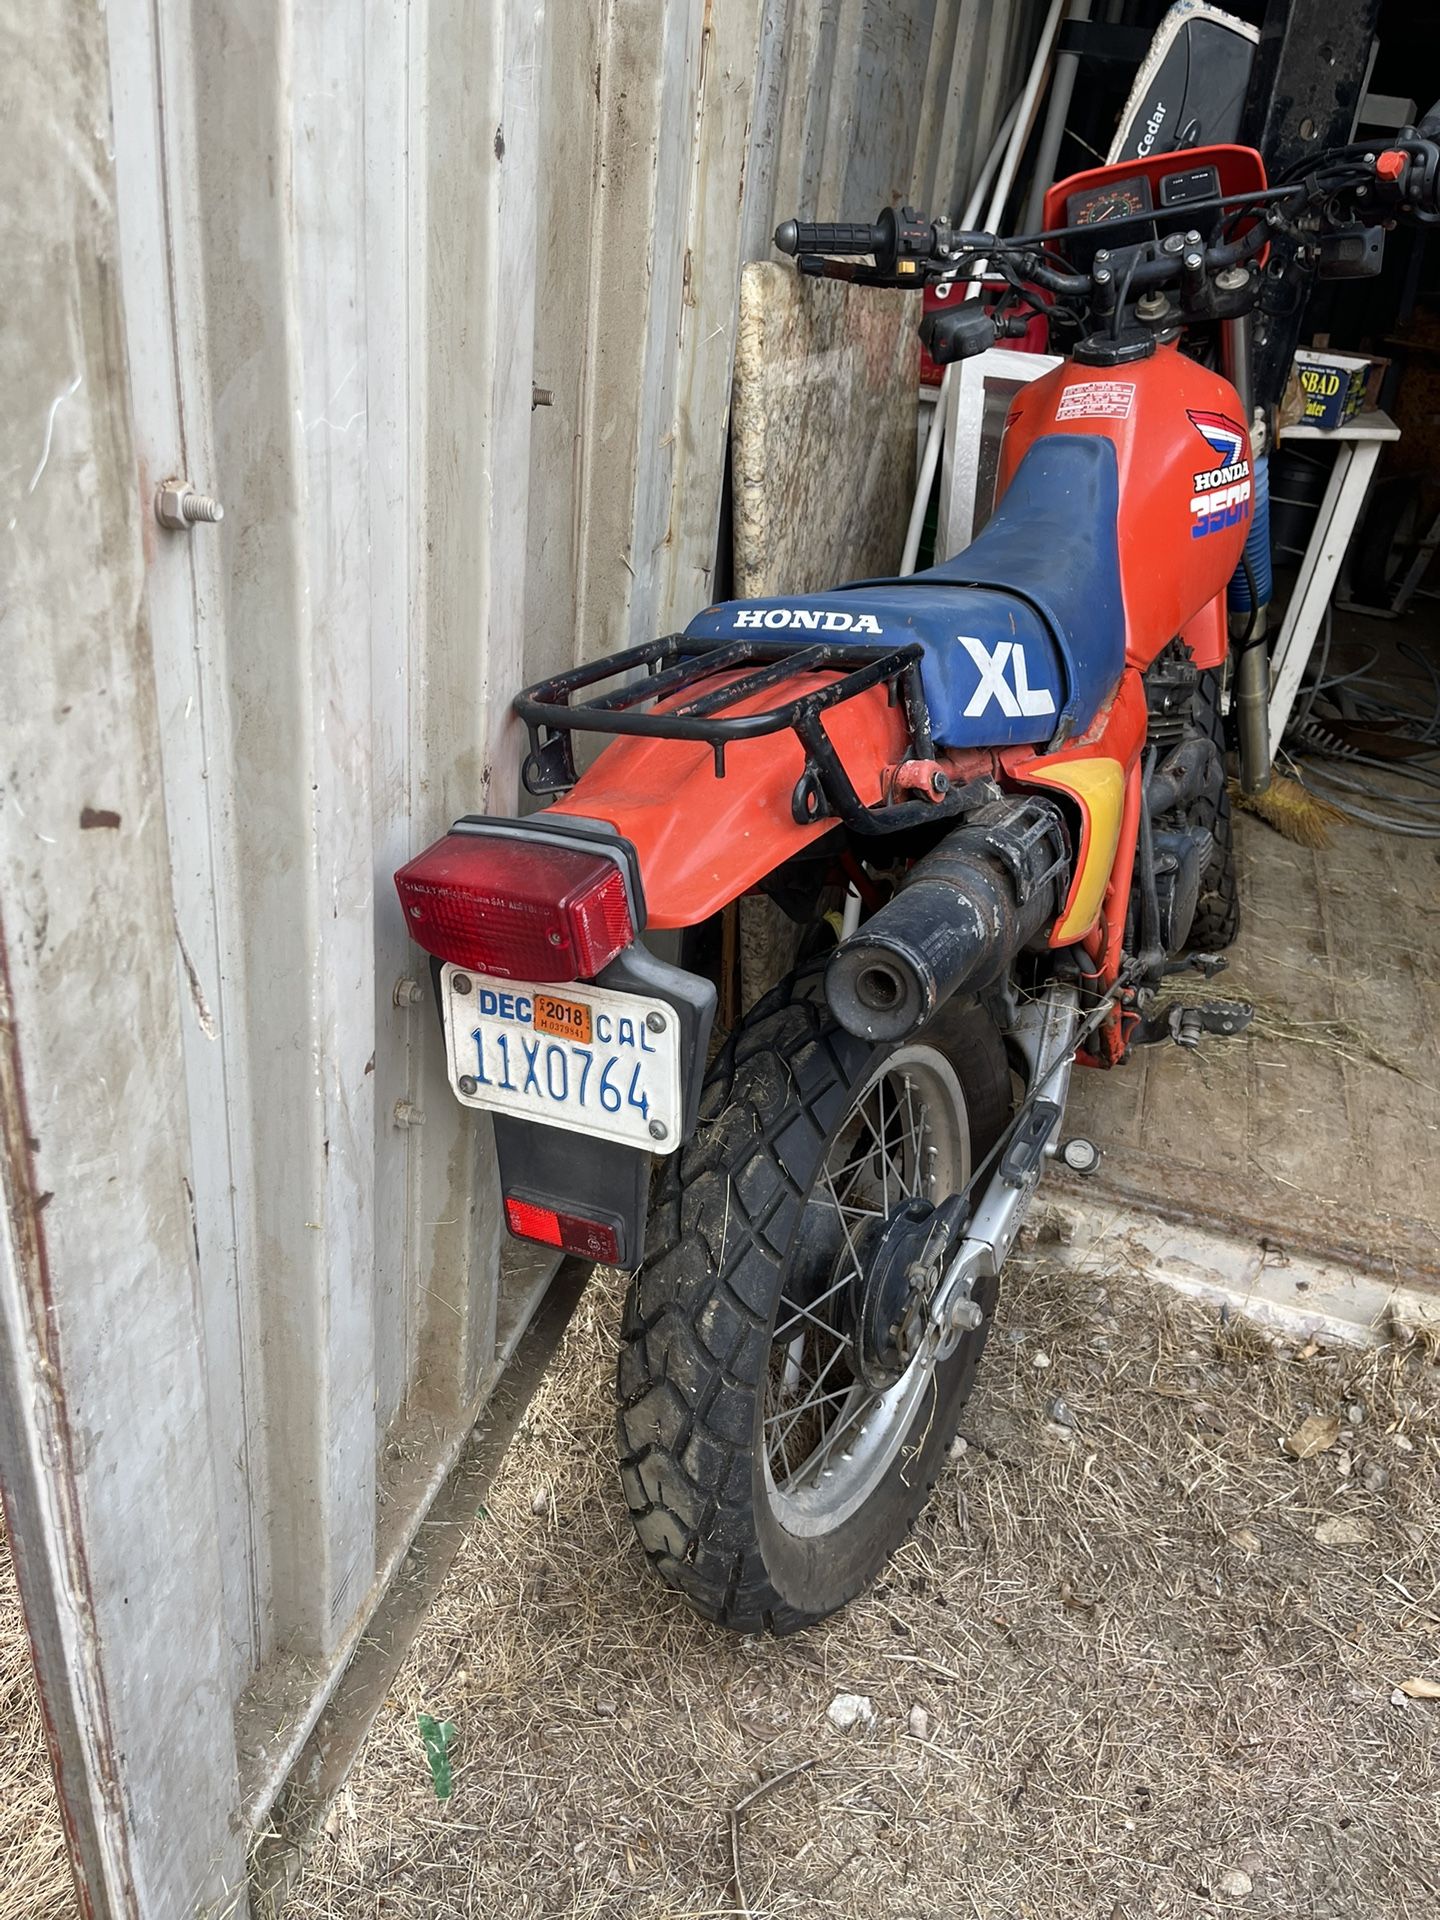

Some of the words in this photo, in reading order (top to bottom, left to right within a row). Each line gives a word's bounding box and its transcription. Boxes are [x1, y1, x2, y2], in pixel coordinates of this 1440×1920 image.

[1194, 460, 1250, 492] HONDA
[1190, 480, 1251, 539] 350R
[732, 609, 883, 634] HONDA
[957, 636, 1056, 718] XL
[479, 988, 533, 1023] DEC
[546, 1001, 583, 1026] 2018
[596, 1014, 657, 1053] CAL
[471, 1027, 650, 1121] 11X0764
